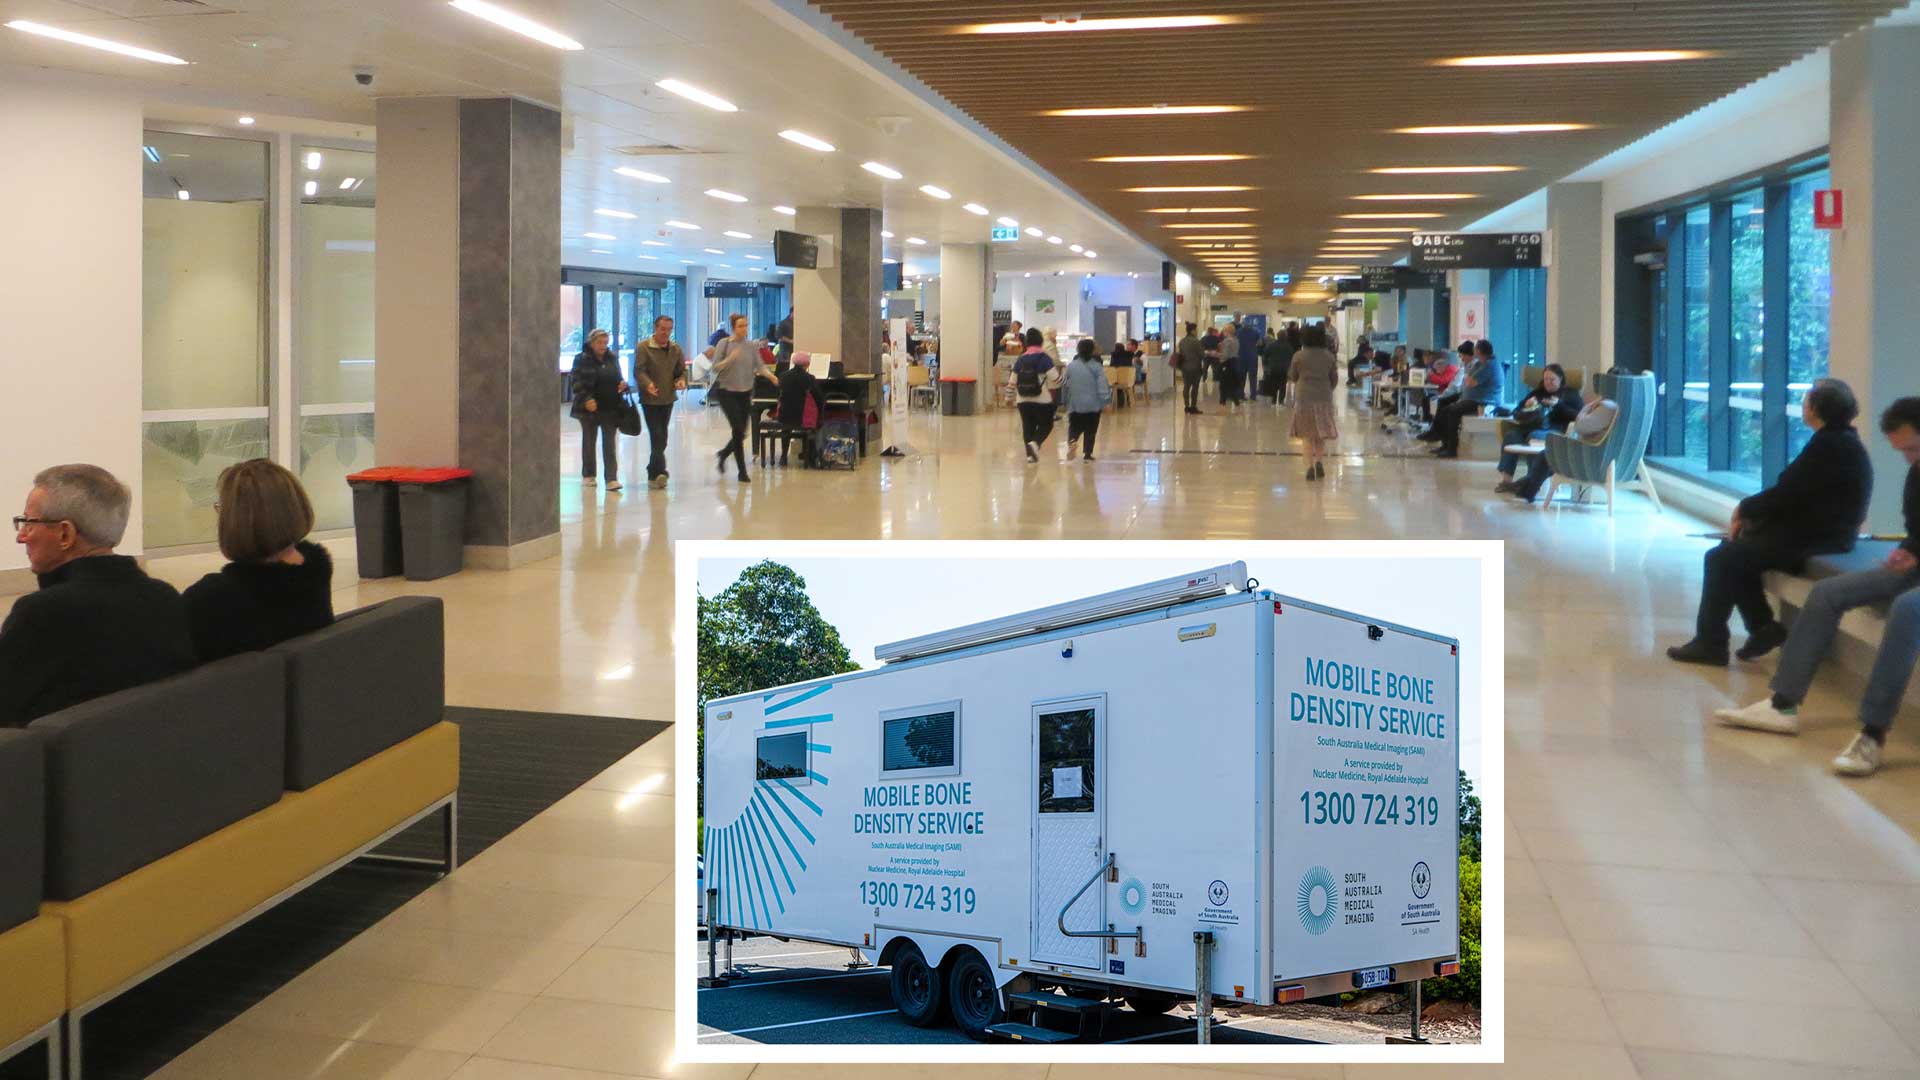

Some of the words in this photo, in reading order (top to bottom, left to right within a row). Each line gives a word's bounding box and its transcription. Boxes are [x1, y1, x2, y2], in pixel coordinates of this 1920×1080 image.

[1306, 656, 1381, 696] MOBILE
[1387, 672, 1434, 704] BONE
[1291, 692, 1374, 730] DENSITY
[1379, 705, 1445, 739] SERVICE
[1317, 736, 1336, 746] South
[1336, 738, 1363, 749] Australia
[1364, 741, 1386, 751] Medical
[1387, 744, 1408, 756] Imaging
[1344, 759, 1349, 767] A
[1350, 760, 1370, 768] service
[1371, 761, 1395, 772] provided
[1396, 762, 1403, 773] by
[1313, 769, 1336, 779] Nuclear
[1338, 771, 1366, 782] Medicine,
[1368, 773, 1383, 784] Royal
[1384, 774, 1406, 783] Adelaide
[1408, 776, 1429, 785] Hospital
[864, 785, 920, 807] MOBILE
[925, 782, 971, 805] BONE
[1300, 791, 1355, 825] 1300
[1362, 794, 1399, 825] 724
[1404, 795, 1438, 826] 319
[854, 813, 914, 834] DENSITY
[918, 812, 984, 834] SERVICE
[925, 843, 944, 852] Imaging
[911, 858, 932, 866] provided
[933, 858, 940, 867] by
[908, 867, 921, 876] Royal
[944, 869, 965, 878] Hospital
[1345, 873, 1366, 883] SOUTH
[860, 881, 899, 907] 1300
[903, 884, 936, 910] 724
[940, 886, 976, 914] 319
[1345, 885, 1382, 897] AUSTRALIA
[1152, 907, 1176, 916] IMAGING
[1345, 900, 1374, 910] MEDICAL
[1345, 913, 1374, 925] IMAGING
